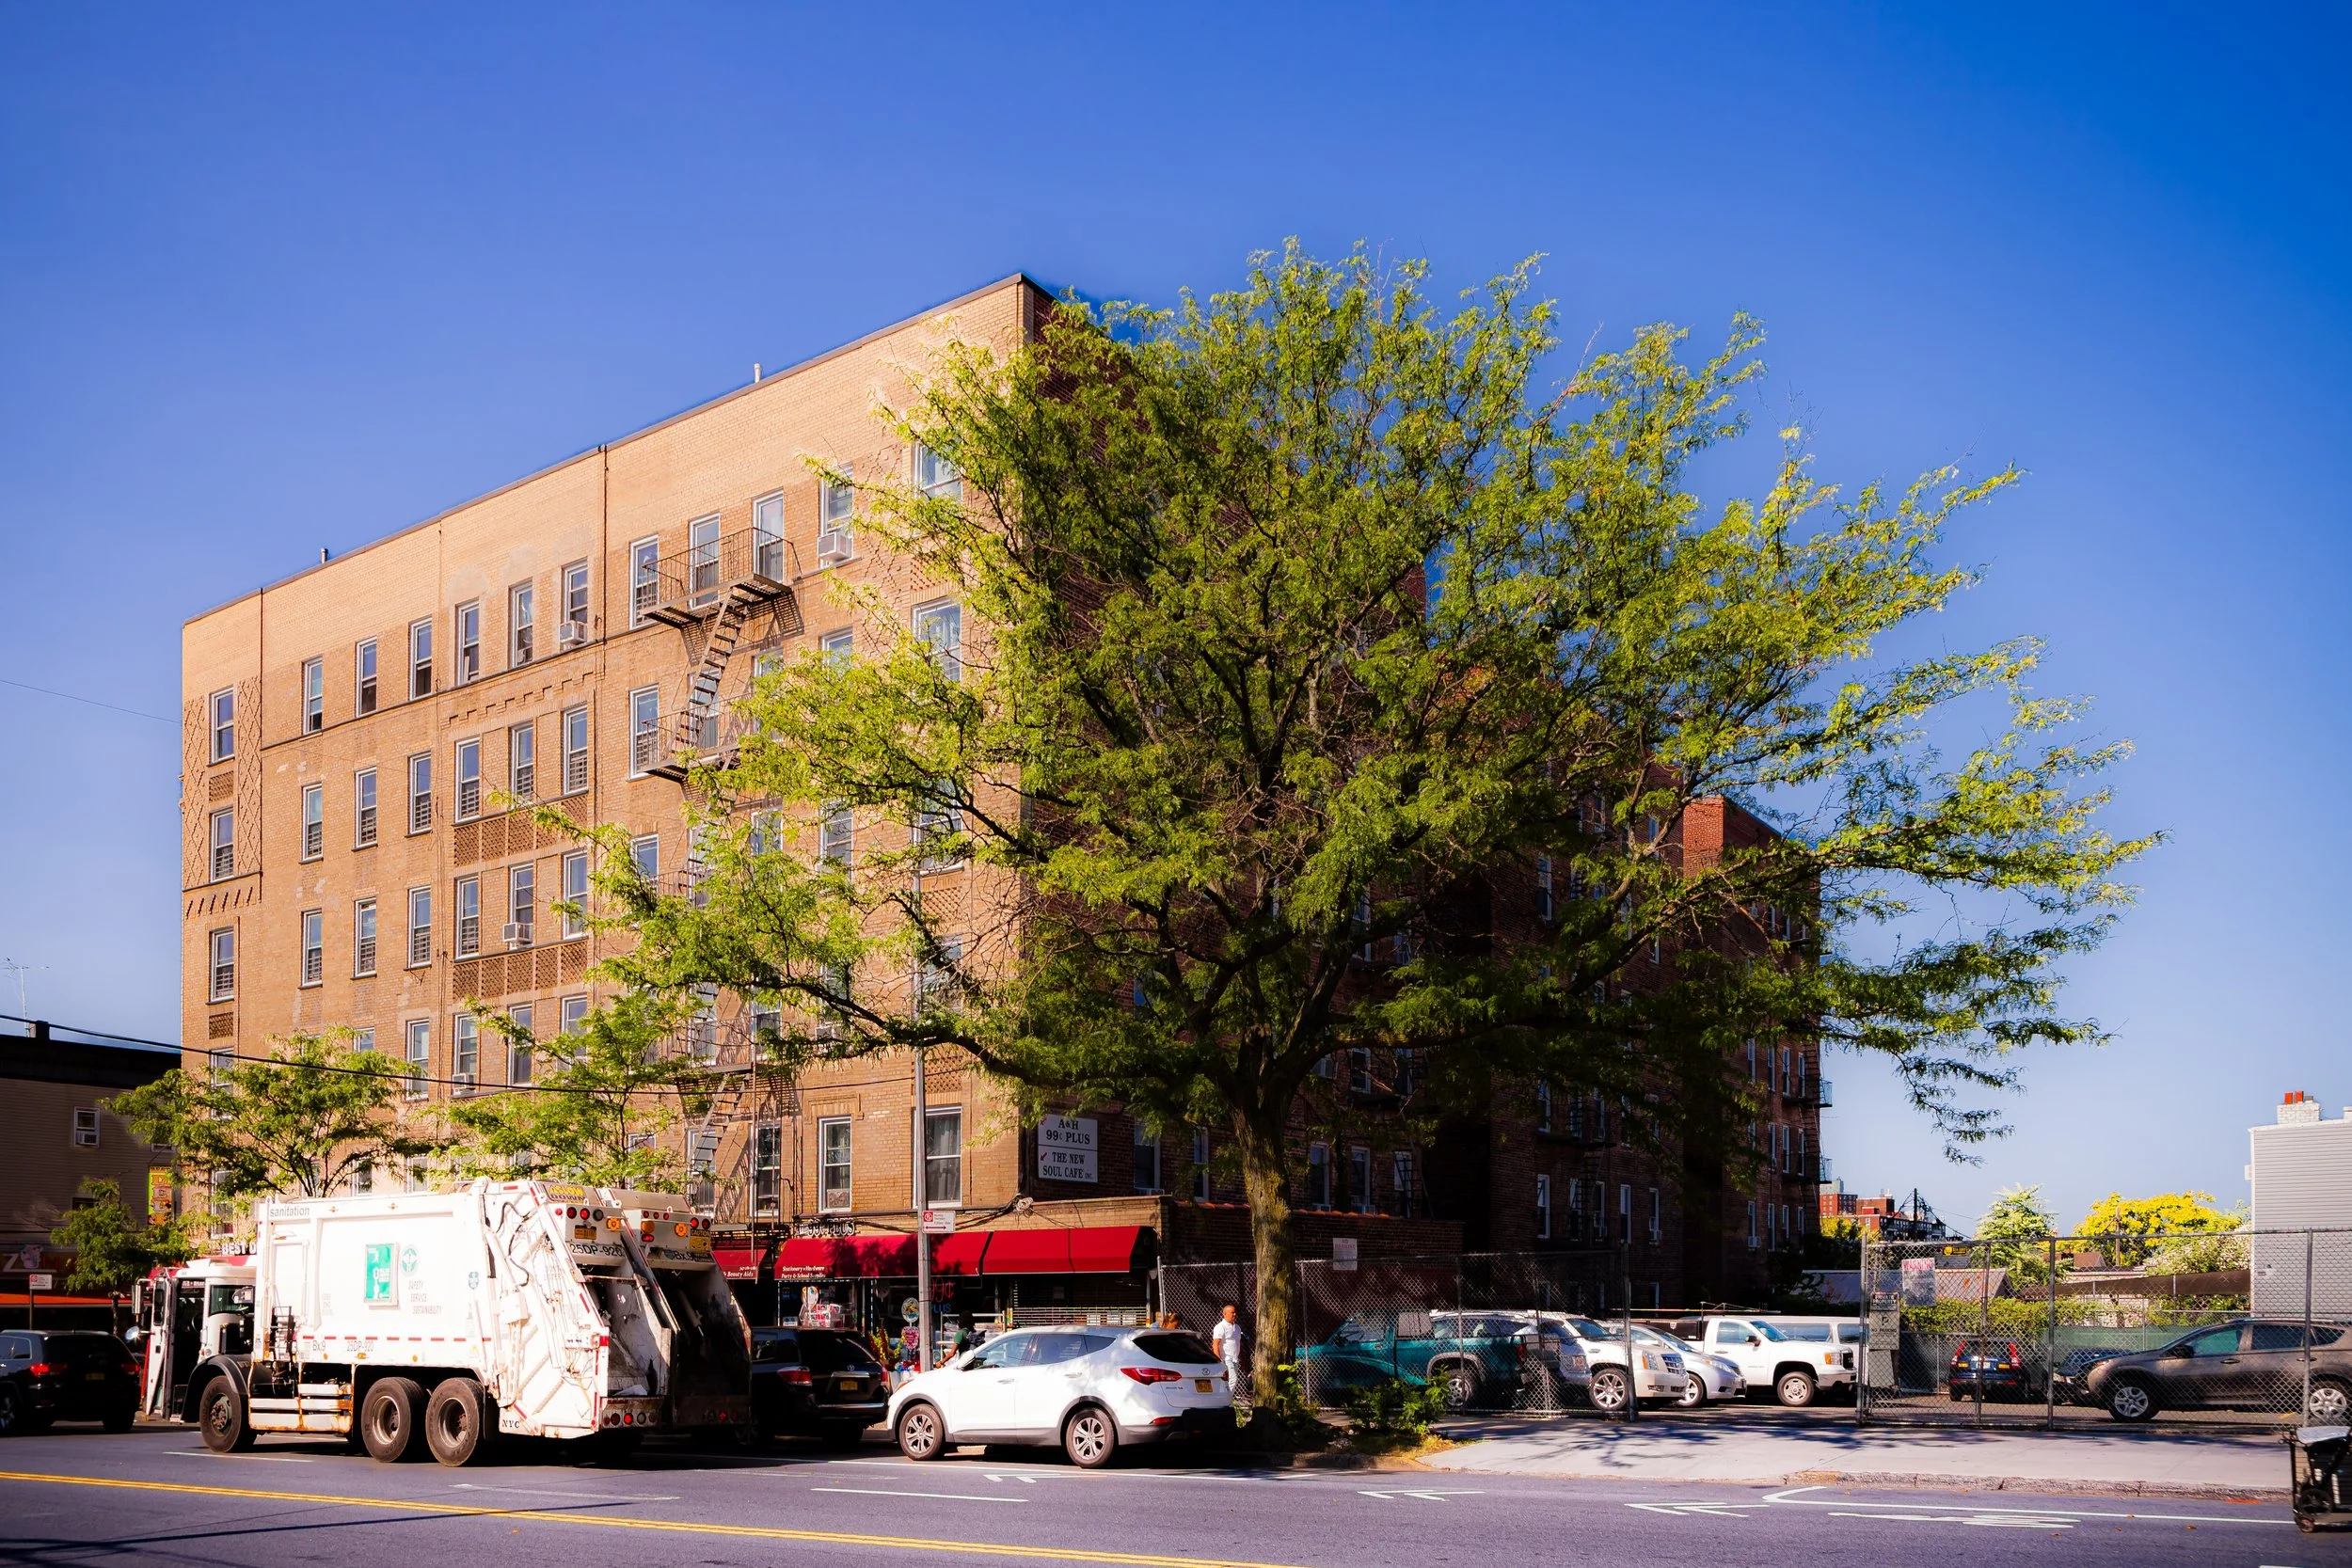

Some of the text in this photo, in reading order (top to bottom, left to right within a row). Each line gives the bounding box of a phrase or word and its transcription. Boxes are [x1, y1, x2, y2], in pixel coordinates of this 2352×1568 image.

[1058, 1119, 1079, 1130] A&H
[1065, 1132, 1090, 1145] PLUS
[1052, 1152, 1085, 1164] THE NEW
[1042, 1165, 1062, 1178] SOUL
[1064, 1167, 1083, 1179] CAFE
[270, 1207, 310, 1217] sanitation
[827, 1217, 855, 1236] PLUS
[222, 1241, 246, 1256] BEST
[502, 1419, 520, 1429] NYC
